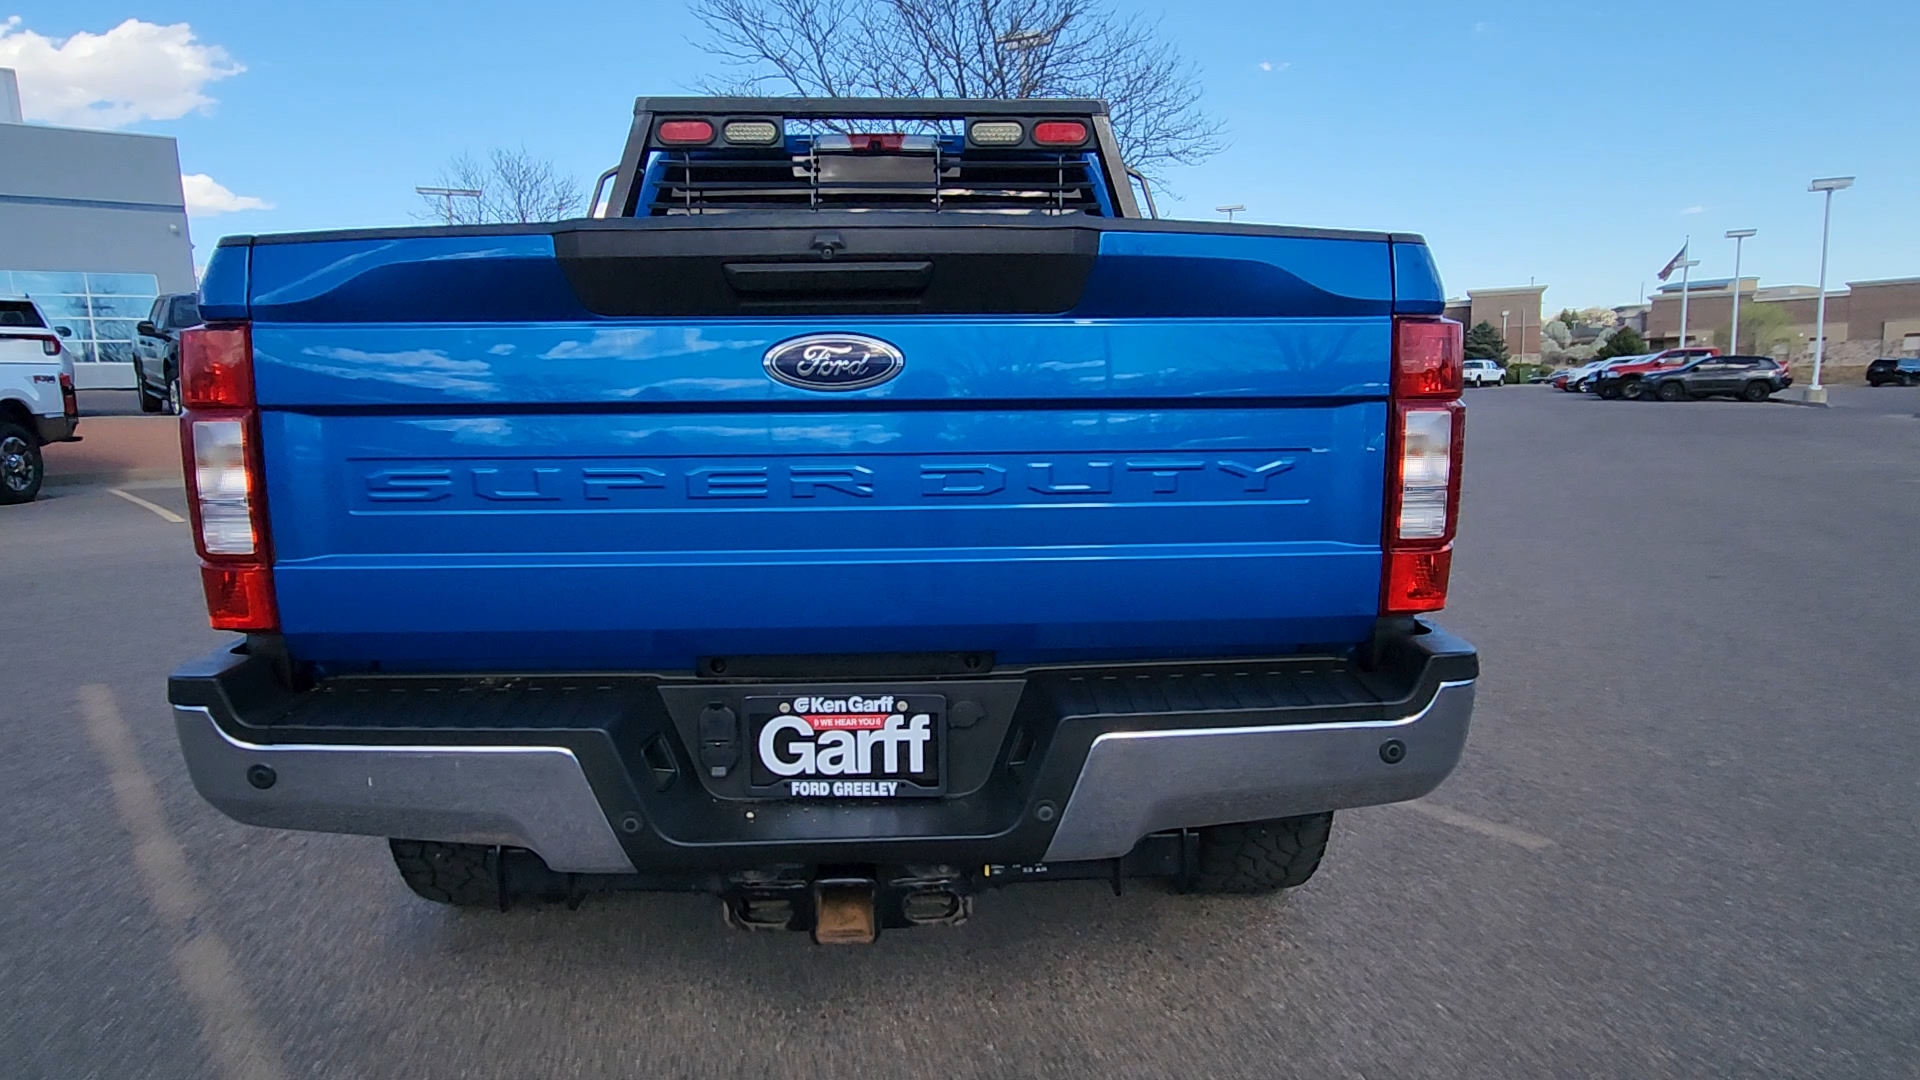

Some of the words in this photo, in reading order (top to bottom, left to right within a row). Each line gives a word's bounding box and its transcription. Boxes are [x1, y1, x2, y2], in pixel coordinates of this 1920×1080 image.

[797, 345, 871, 376] Ford
[365, 465, 874, 502] SUPER
[919, 458, 1296, 498] DUTY
[811, 697, 846, 713] Ken
[847, 696, 894, 713] Garff
[834, 718, 857, 726] HEAR
[857, 718, 875, 726] YOU
[758, 714, 931, 776] Garff
[791, 782, 830, 797] FORD
[832, 781, 898, 797] GREELEY
